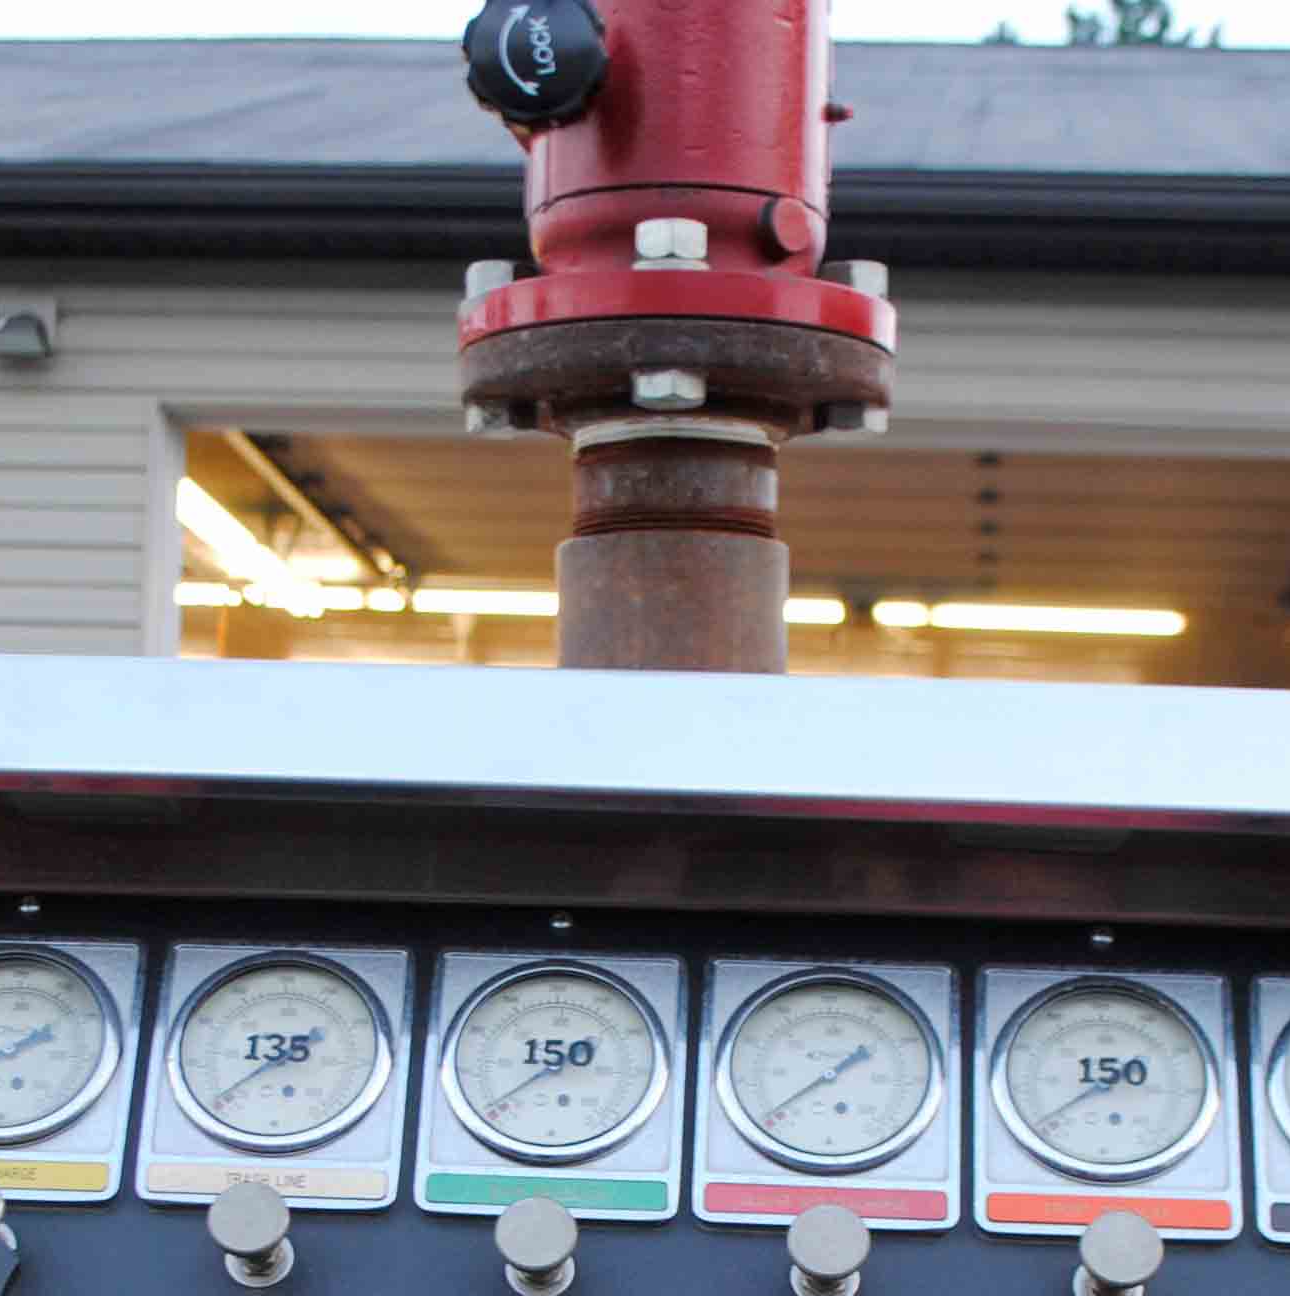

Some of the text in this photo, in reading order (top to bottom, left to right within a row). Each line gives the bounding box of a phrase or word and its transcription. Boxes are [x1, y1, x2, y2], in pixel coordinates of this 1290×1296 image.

[530, 16, 556, 76] LOCK
[246, 1033, 310, 1062] 135
[524, 1038, 594, 1067] 150
[1079, 1057, 1147, 1086] 150
